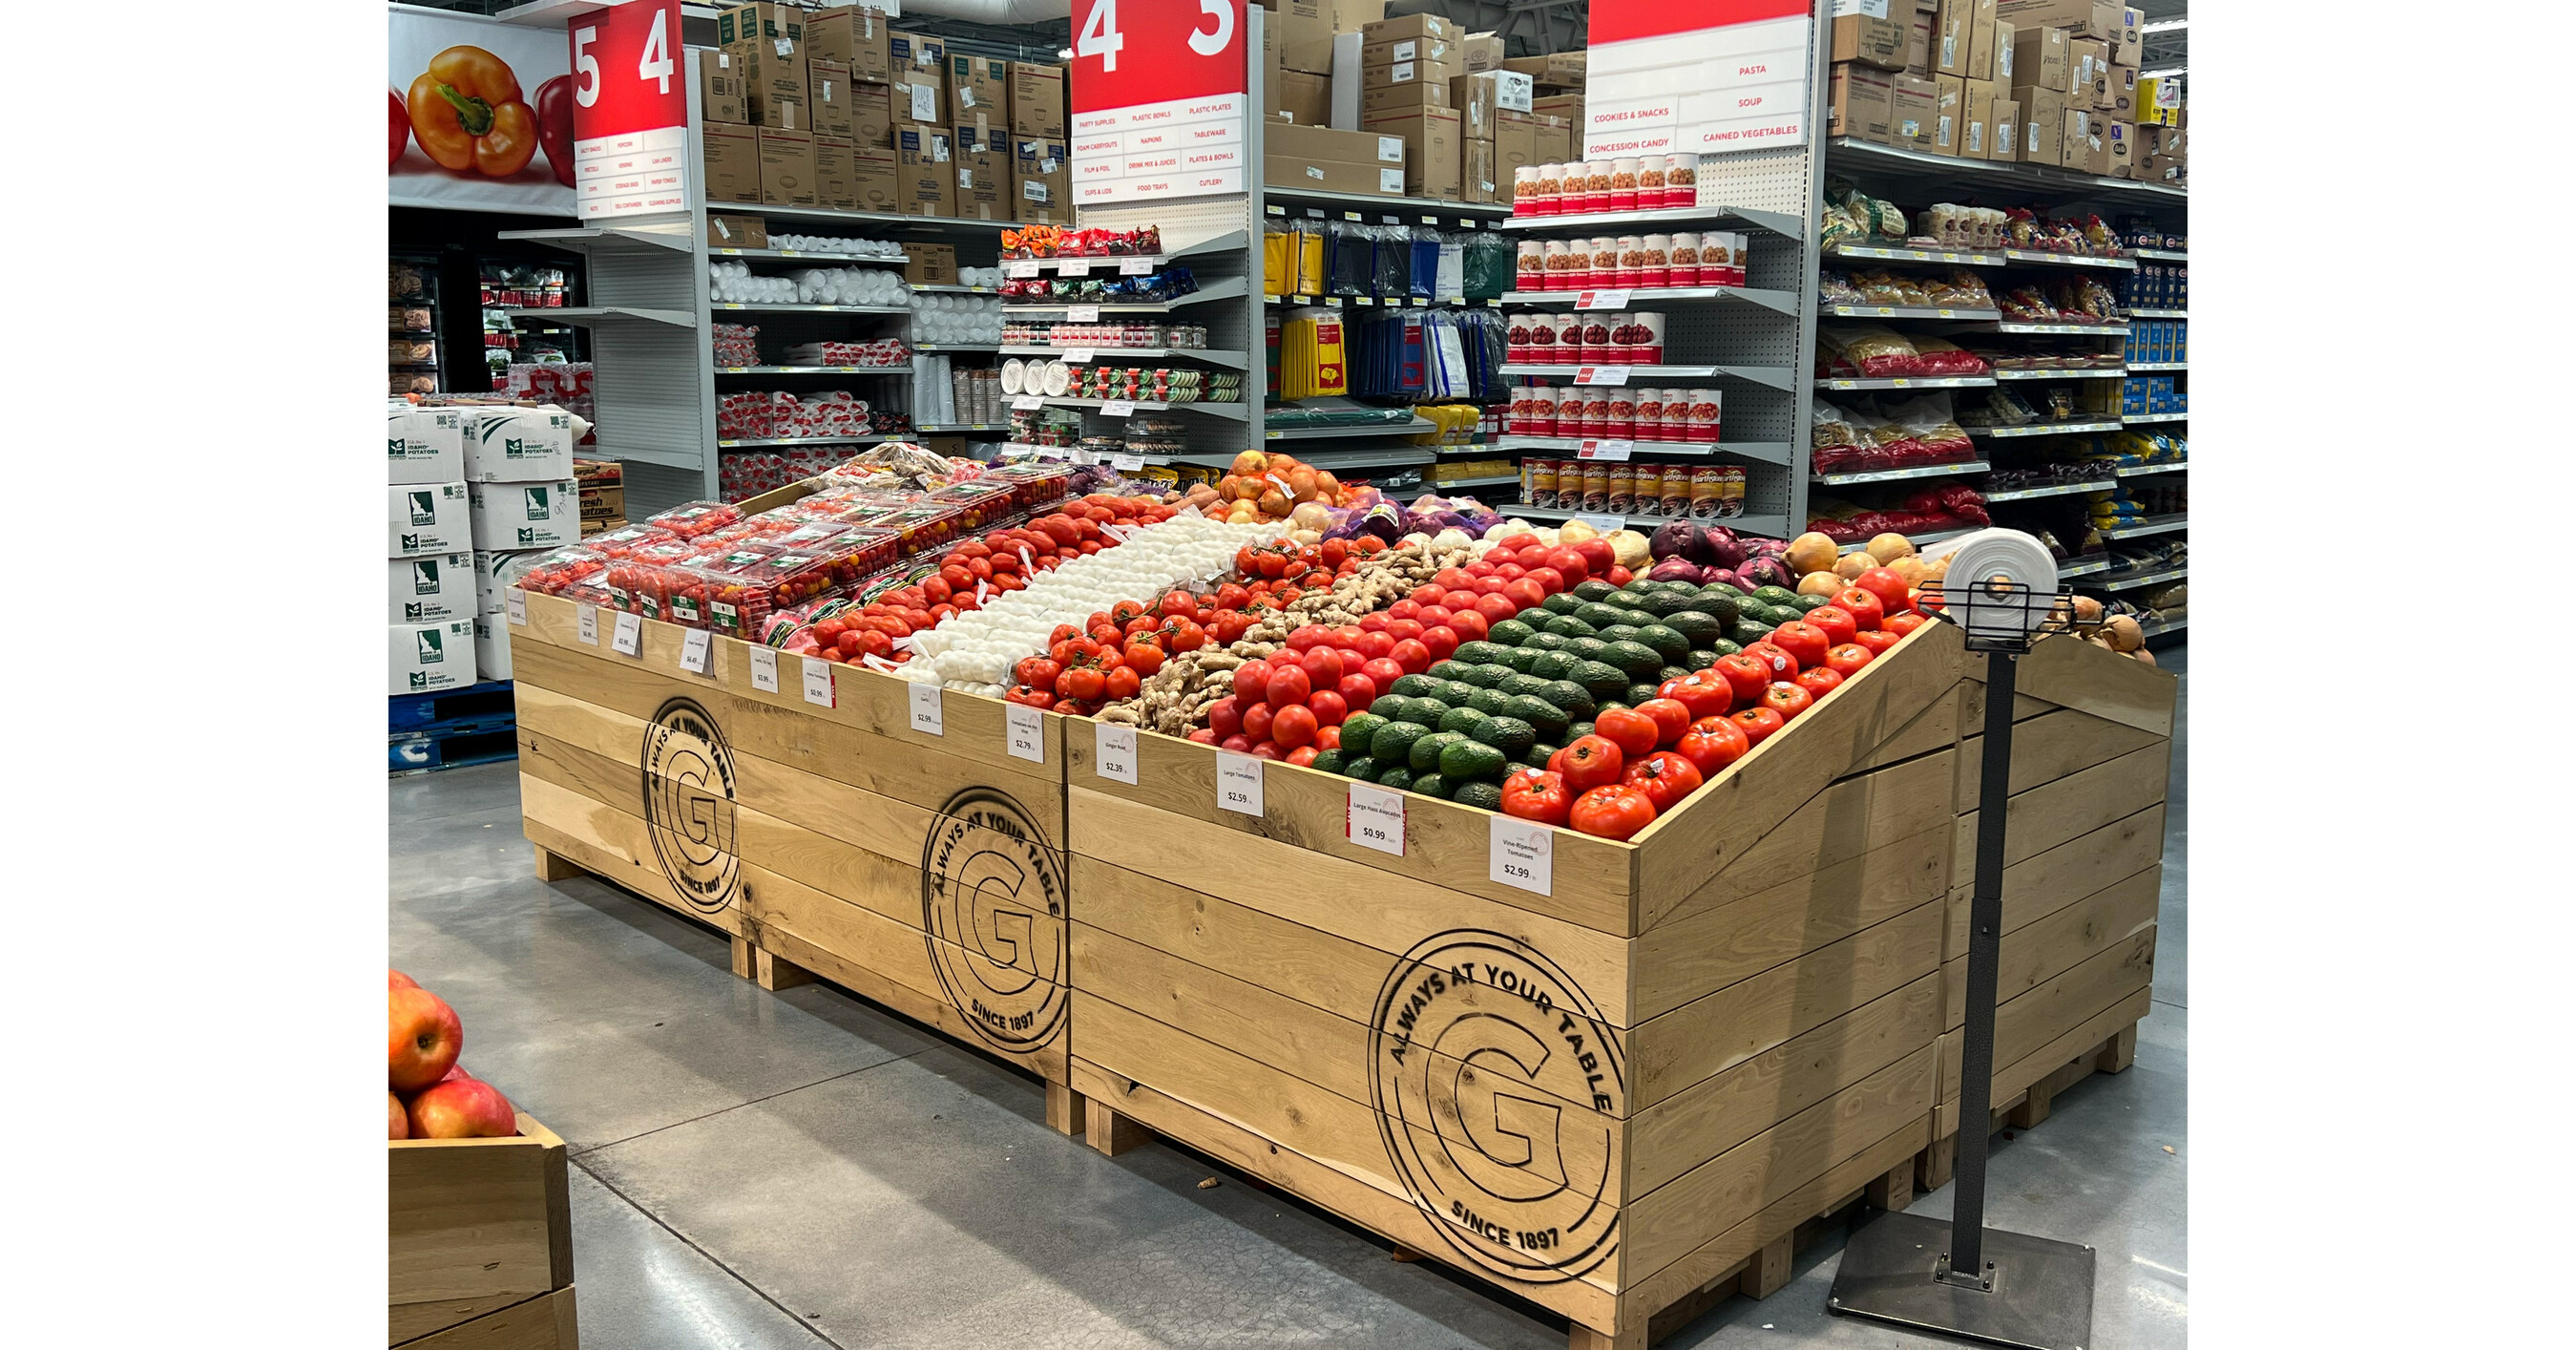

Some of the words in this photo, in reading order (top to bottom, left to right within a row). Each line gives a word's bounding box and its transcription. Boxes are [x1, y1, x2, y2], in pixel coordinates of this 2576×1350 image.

[1077, 0, 1123, 73] 4
[639, 8, 674, 95] 4
[576, 25, 600, 108] 5
[1739, 65, 1767, 76] PASTA
[1738, 97, 1762, 108] SOUP
[1189, 105, 1210, 115] PLASTIC
[1211, 103, 1231, 112] PLATES
[1153, 111, 1171, 119] BOWLS
[1594, 112, 1628, 123] COOKIES
[1630, 111, 1635, 119] &
[1638, 107, 1669, 118] SNACKS
[1095, 118, 1116, 127] SUPPLIES
[1194, 129, 1226, 138] TABLEWARE
[1704, 131, 1740, 142] CANNED
[1742, 125, 1798, 138] VEGETABLES
[1090, 141, 1118, 150] CARRYOUTS
[1141, 136, 1162, 144] NAPKINS
[1589, 140, 1639, 154] CONCESSION
[1641, 137, 1669, 148] CANDY
[1213, 153, 1234, 161] BOWLS
[1199, 179, 1223, 187] CUTLERY
[580, 497, 603, 508] resh
[580, 507, 614, 517] matoes
[413, 516, 432, 524] IDAHO
[418, 584, 437, 593] IDAHO
[422, 653, 441, 662] IDAHO
[757, 674, 768, 683] $3.99
[810, 689, 823, 698] $0.99
[917, 713, 932, 723] $2.99
[1016, 739, 1031, 749] $2.79
[1105, 742, 1117, 750] Ginger
[651, 728, 668, 791] ALWAYS
[669, 717, 681, 736] AT
[683, 717, 709, 746] YOUR
[709, 743, 734, 800] TABLE
[1106, 762, 1123, 773] $2.39
[1224, 770, 1235, 778] Large
[1235, 771, 1255, 781] Tomatoes
[1227, 791, 1247, 803] $2.59
[1353, 802, 1367, 811] Large
[1379, 809, 1401, 818] Avocados
[1363, 827, 1386, 840] $0.99
[1503, 839, 1538, 853] Vine-Ripened
[1507, 849, 1534, 860] Tomatoes
[934, 822, 964, 897] ALWAYS
[966, 812, 982, 831] AT
[987, 812, 1027, 848] YOUR
[1029, 844, 1059, 917] TABLE
[1504, 864, 1529, 878] $2.99
[680, 868, 704, 894] SINCE
[704, 877, 721, 894] 1897
[972, 999, 1006, 1030] SINCE
[1010, 1011, 1034, 1031] 1897
[1390, 971, 1445, 1066] ALWAYS
[1452, 962, 1475, 986] AT
[1484, 963, 1553, 1016] YOUR
[1558, 1013, 1613, 1113] TABLE
[1451, 1199, 1510, 1245] SINCE
[1516, 1227, 1560, 1250] 1897
